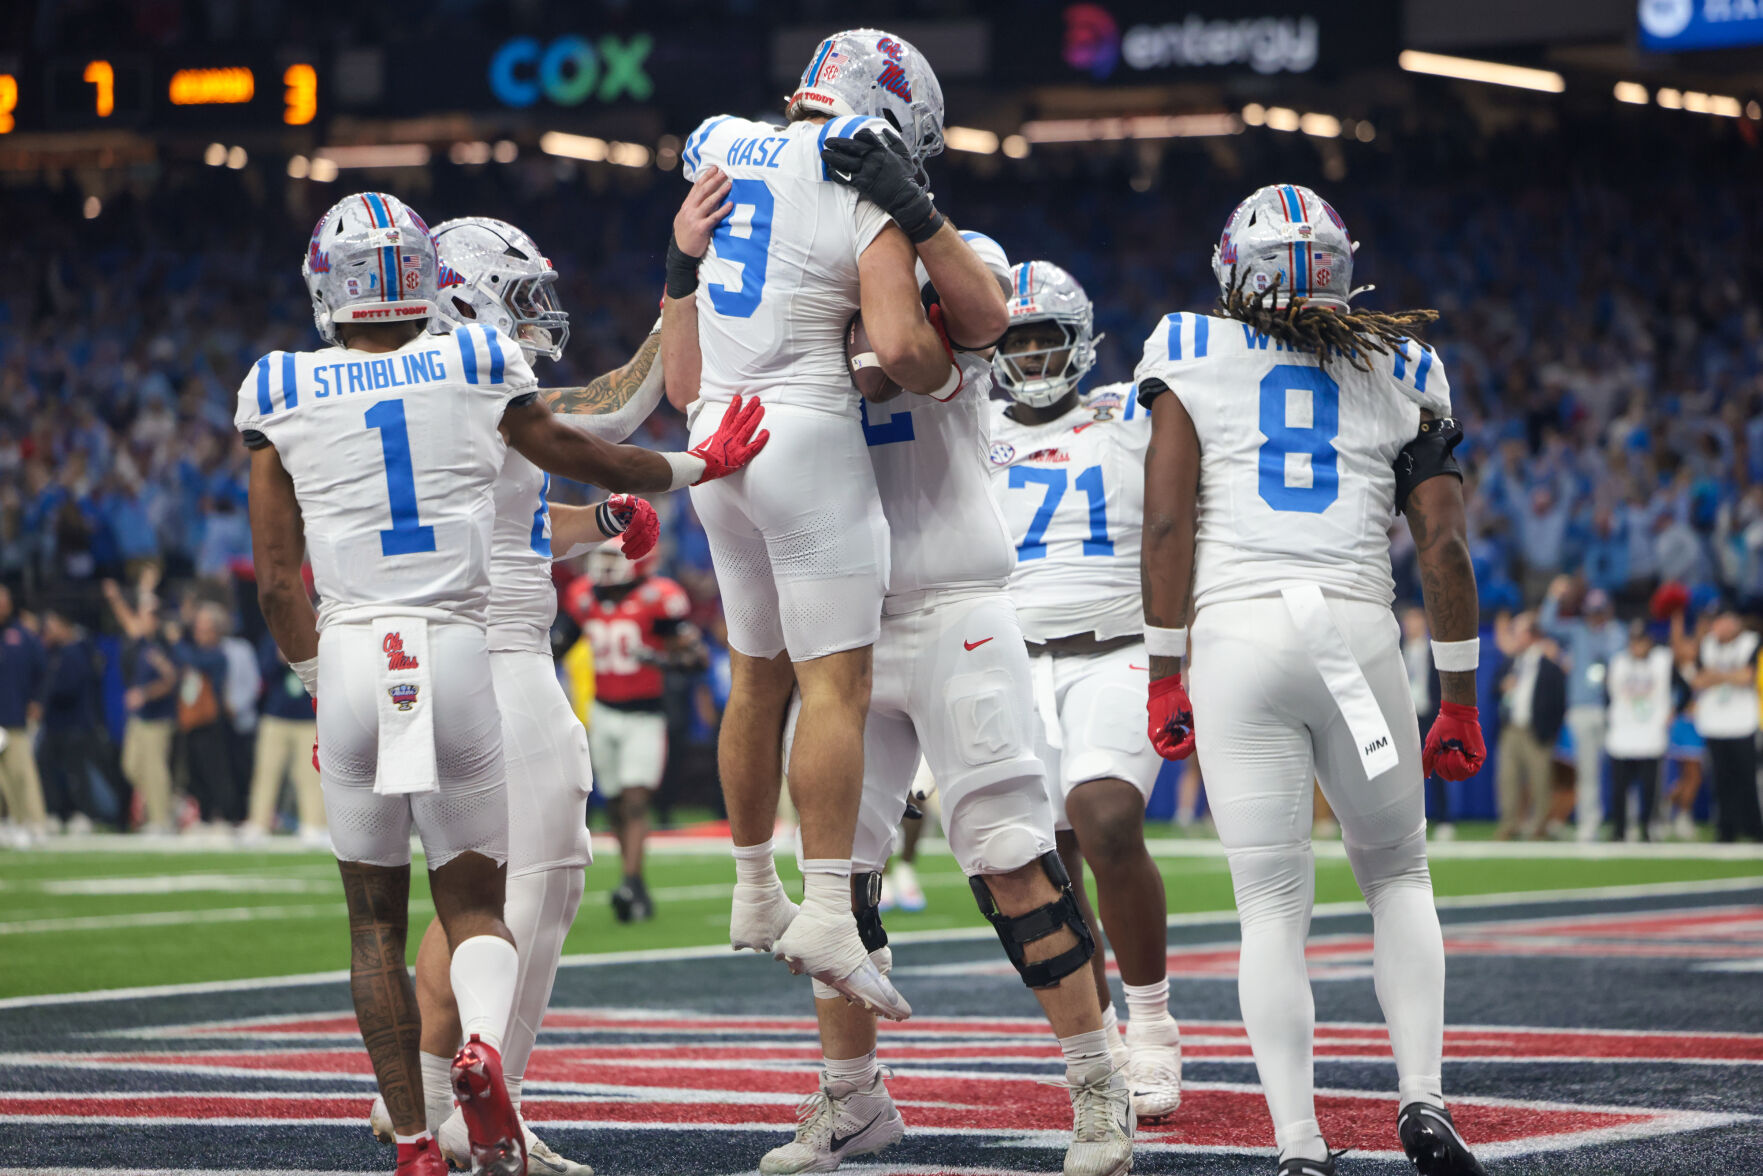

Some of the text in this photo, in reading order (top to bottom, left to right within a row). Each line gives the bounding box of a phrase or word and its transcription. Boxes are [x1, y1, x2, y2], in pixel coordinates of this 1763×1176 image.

[1122, 15, 1319, 74] entergy
[490, 35, 653, 107] COX
[823, 64, 839, 81] SEC
[283, 63, 317, 126] 3
[804, 91, 835, 106] TODDY
[727, 137, 790, 169] HASZ
[707, 178, 775, 319] 9
[405, 271, 419, 290] SEC
[1316, 268, 1330, 287] SEC
[352, 309, 391, 319] HOTTY
[314, 350, 446, 399] STRIBLING
[1258, 364, 1339, 514] 8
[364, 398, 436, 557] 1
[1008, 464, 1115, 562] 71
[383, 632, 403, 652] Ole
[387, 650, 419, 671] Miss
[1365, 736, 1388, 756] HIM
